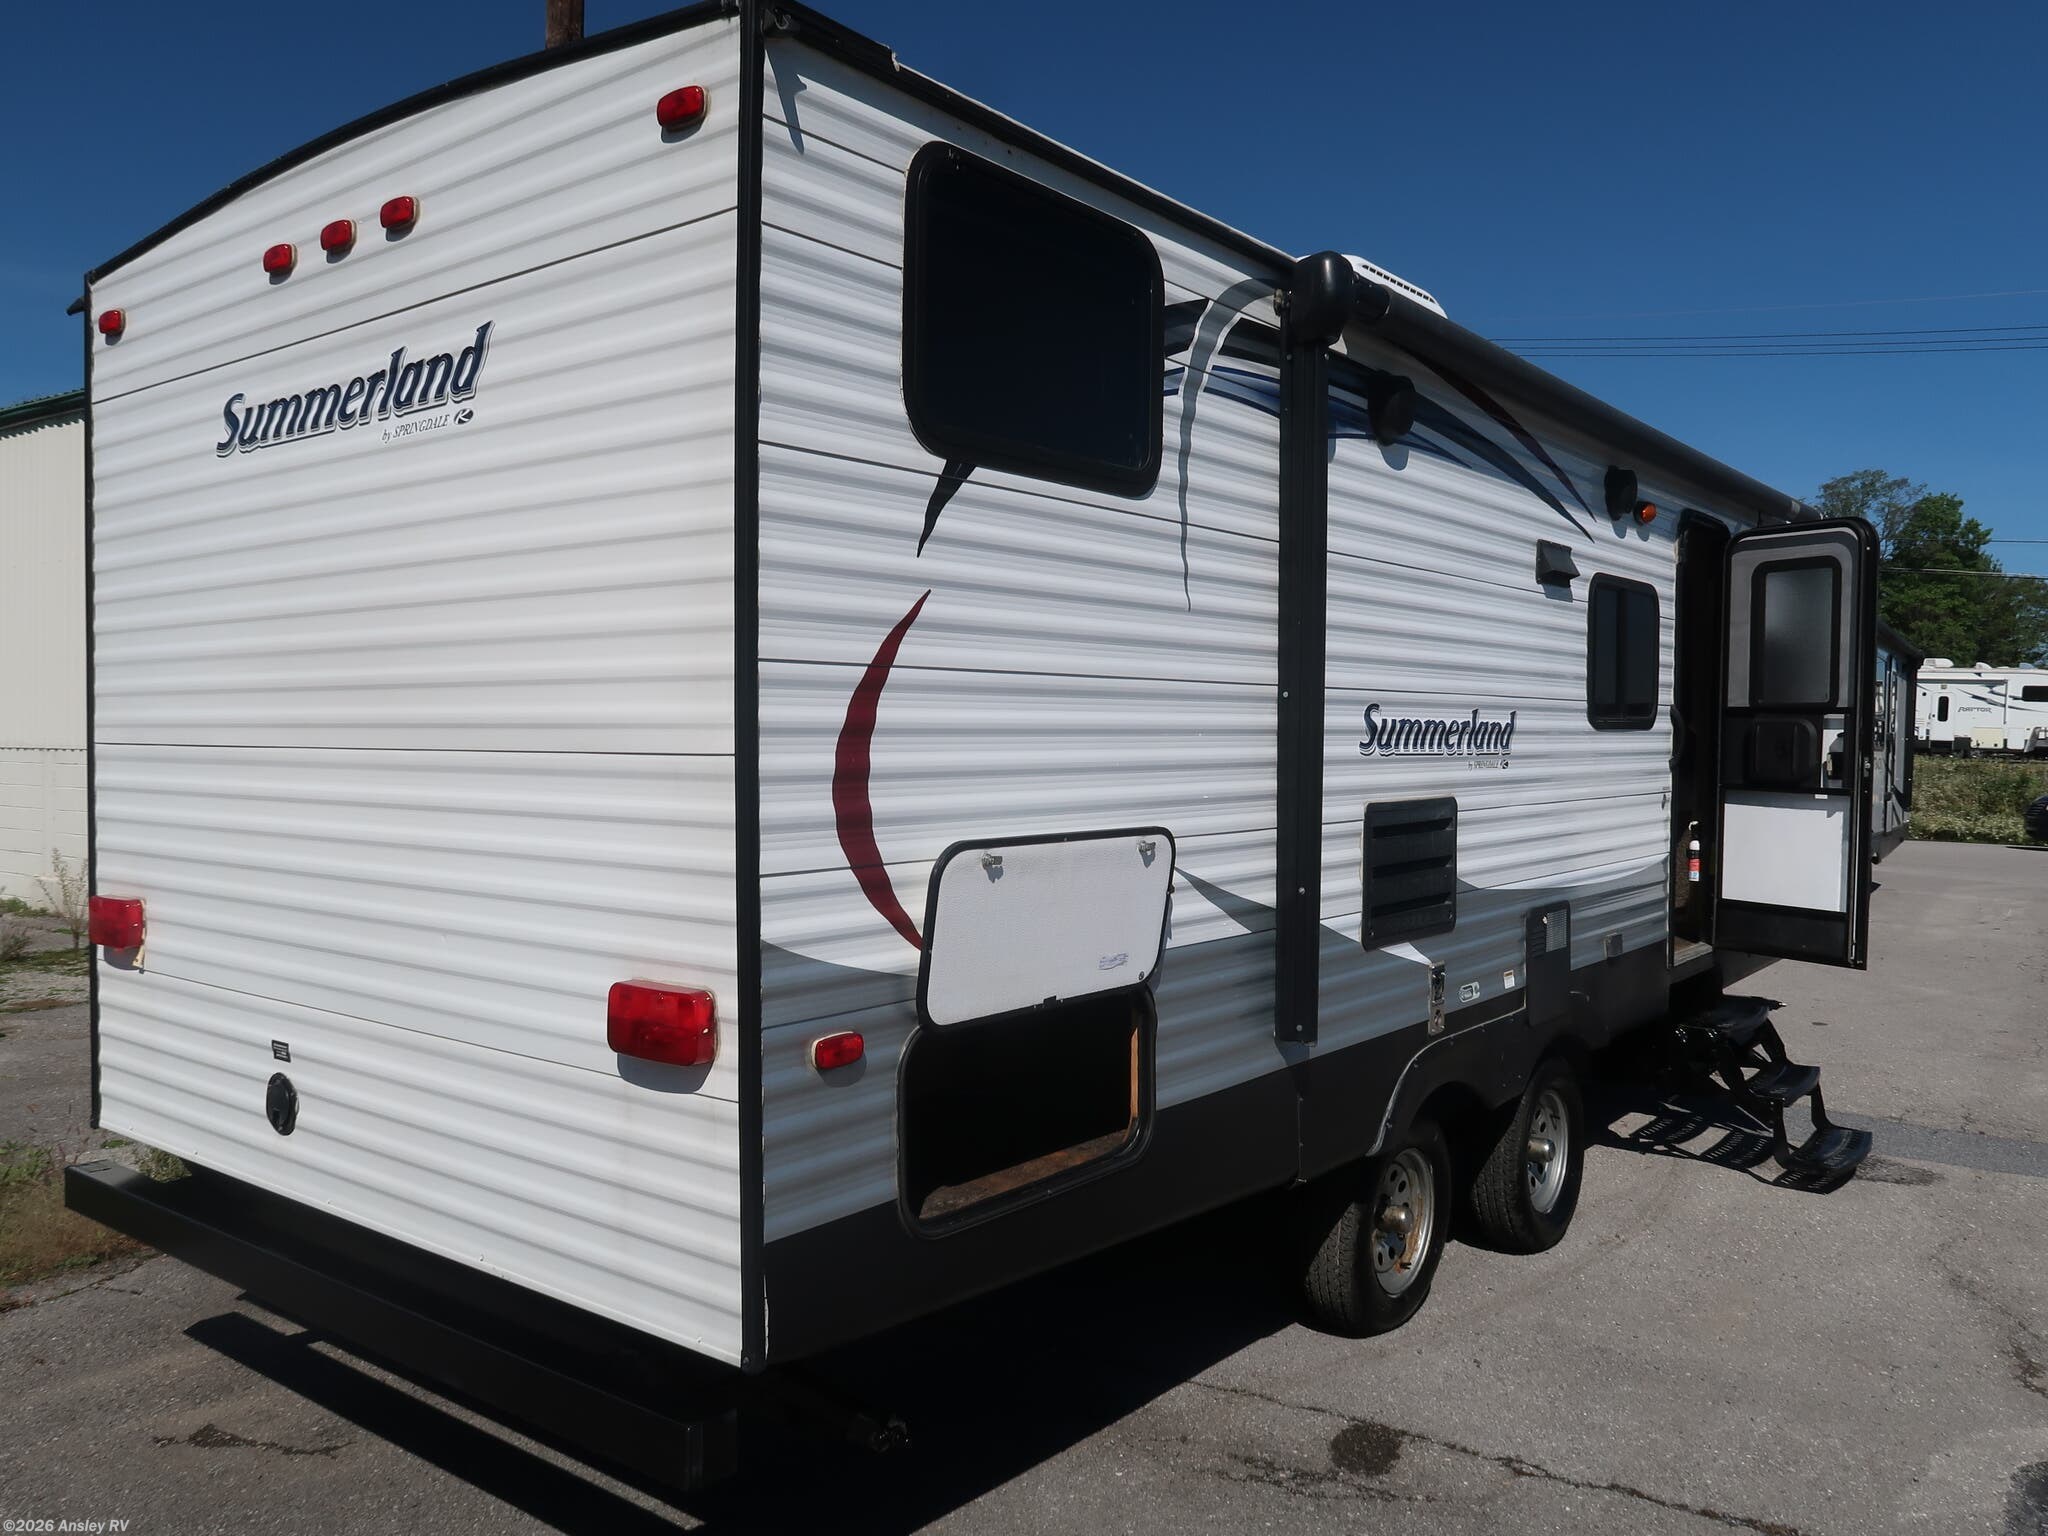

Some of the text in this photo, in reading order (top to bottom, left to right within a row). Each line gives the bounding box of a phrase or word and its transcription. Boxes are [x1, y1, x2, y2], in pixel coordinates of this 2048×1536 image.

[216, 320, 495, 458] Summerland
[382, 428, 392, 444] by
[392, 414, 450, 439] SPRINGDALE
[1359, 703, 1517, 757] Summerland
